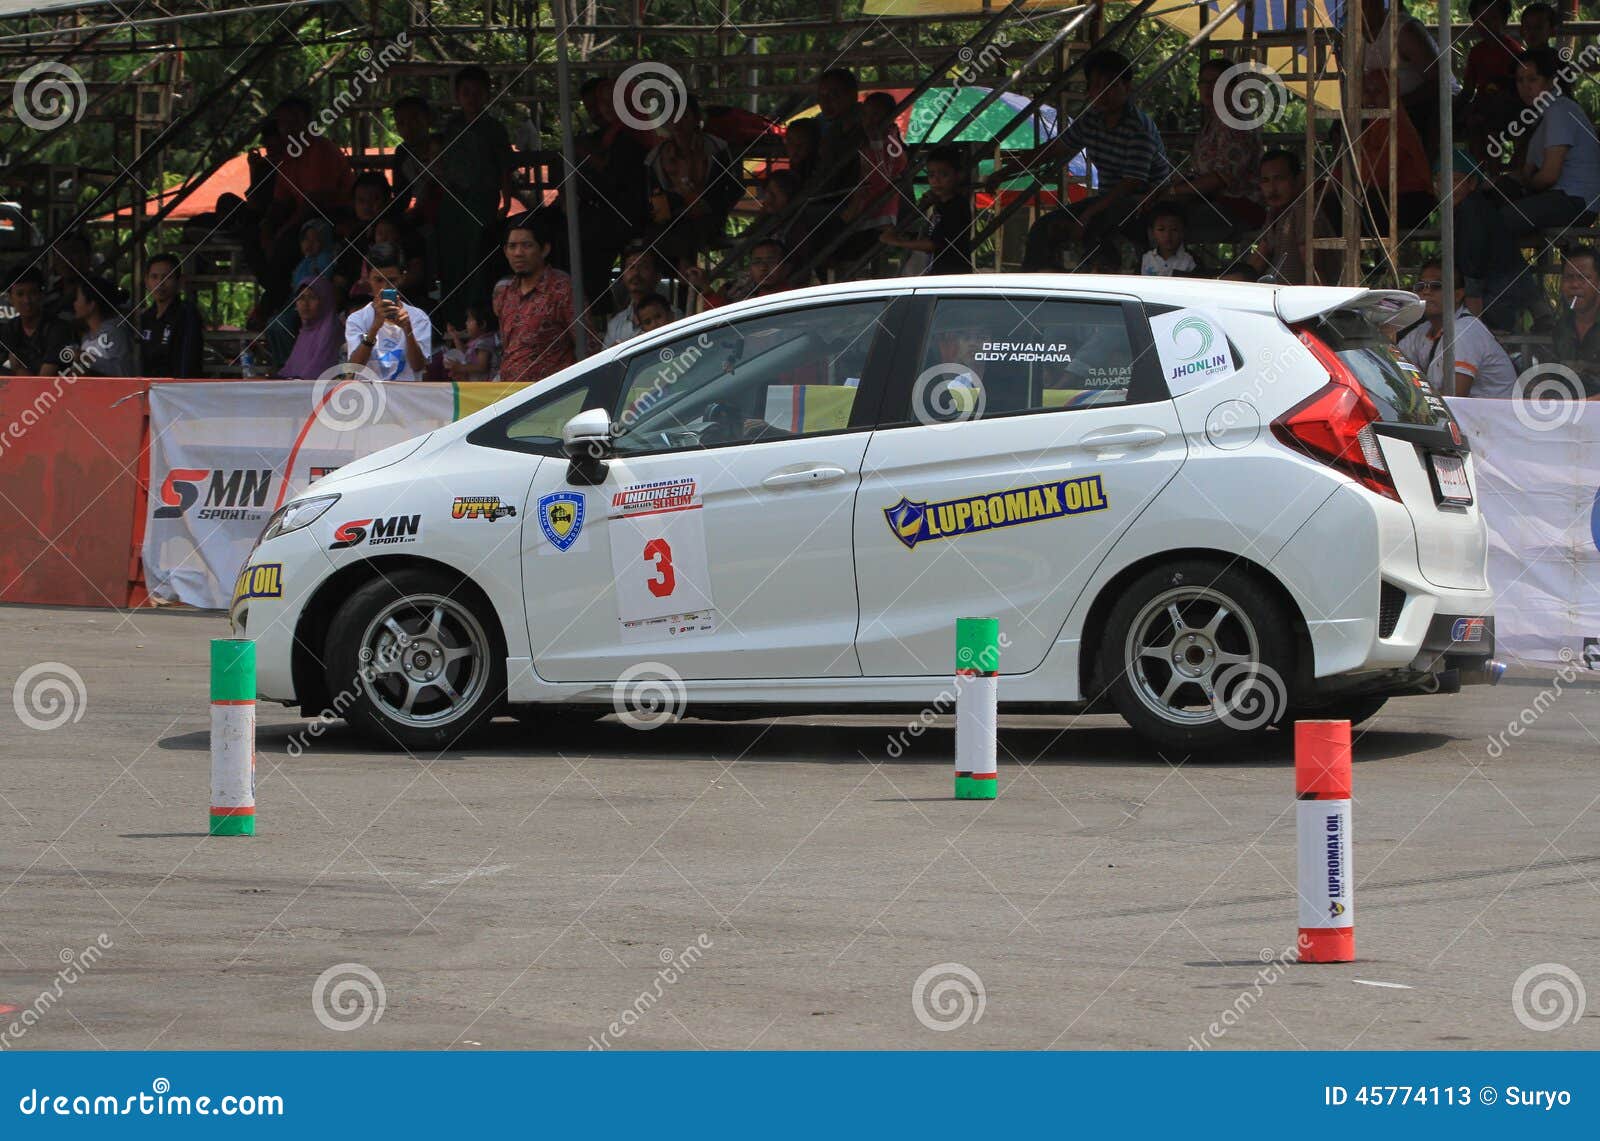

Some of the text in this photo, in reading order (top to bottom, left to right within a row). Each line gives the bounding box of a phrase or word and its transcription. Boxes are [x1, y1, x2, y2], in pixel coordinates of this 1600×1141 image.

[974, 352, 1072, 363] OLDY ARDHANA
[982, 342, 1067, 352] DERVIAN AP
[1171, 354, 1226, 380] JHONLIN
[1205, 364, 1228, 375] GROUP
[153, 468, 273, 519] SMN
[624, 484, 693, 504] INDONESIA
[630, 479, 679, 490] LUPROMAX
[452, 502, 500, 519] UTV
[926, 479, 1104, 535] LUPROMAX OIL
[328, 514, 422, 550] SMN
[253, 566, 279, 593] OIL
[643, 538, 676, 598] 3
[1326, 813, 1341, 898] LUPROMAX OIL
